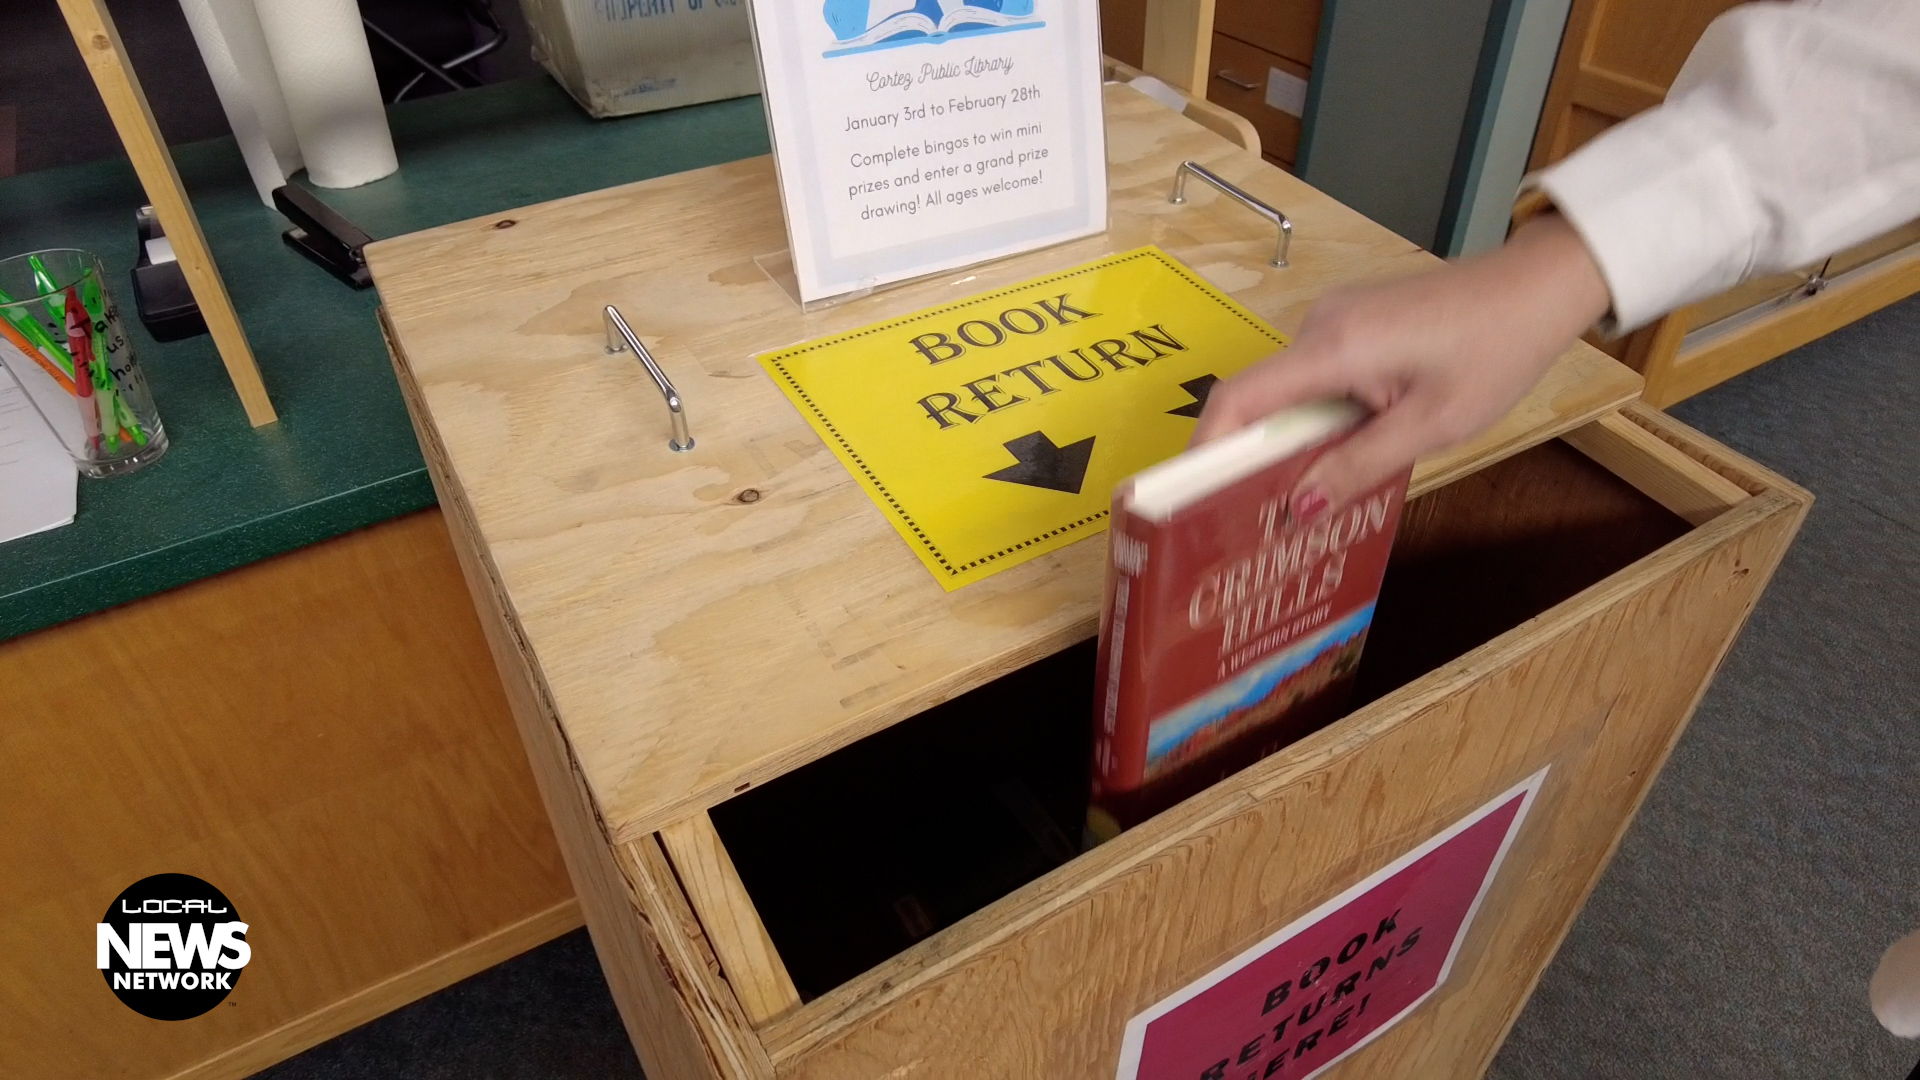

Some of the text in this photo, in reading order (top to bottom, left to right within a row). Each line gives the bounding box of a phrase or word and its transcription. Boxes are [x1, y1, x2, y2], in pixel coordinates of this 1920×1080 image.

[845, 84, 1041, 132] January 3rd to February 28th
[866, 56, 1014, 92] Cortez Public Library
[848, 147, 1049, 200] prizes and enter a grand prize
[850, 121, 1042, 168] Complete bingos to win mini
[860, 169, 1043, 220] drawing! All ages welcome!
[907, 292, 1104, 366] BOOK
[916, 323, 1190, 431] RETURN
[1189, 486, 1397, 630] CRIMSON
[1260, 908, 1402, 1017] BOOK
[1200, 926, 1424, 1080] RETURNS
[1246, 992, 1371, 1080] ERE!
